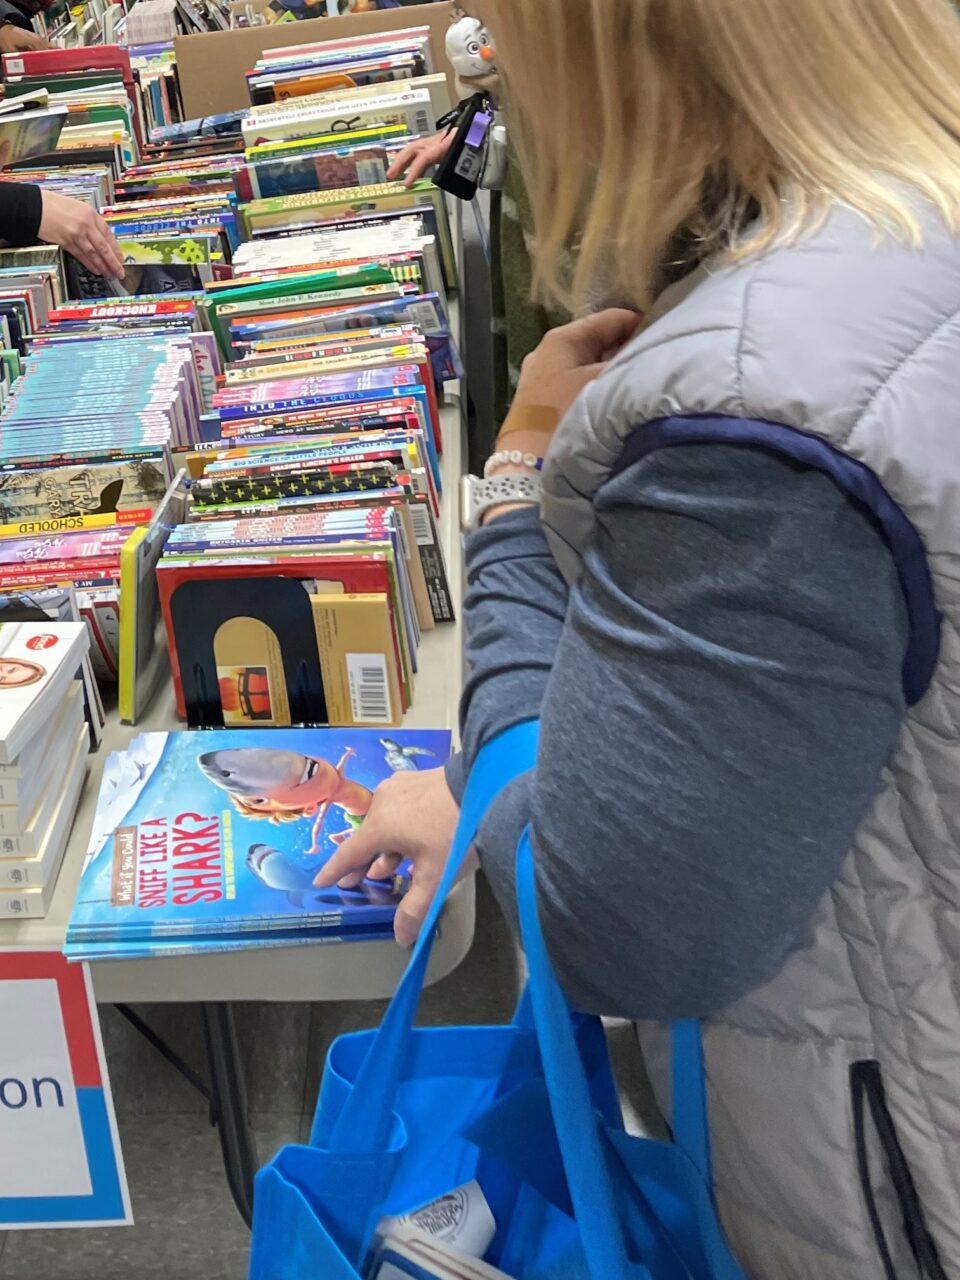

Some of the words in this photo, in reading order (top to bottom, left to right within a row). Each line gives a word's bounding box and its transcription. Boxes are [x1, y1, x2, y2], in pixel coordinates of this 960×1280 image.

[90, 303, 156, 317] KNOCKOUT
[244, 402, 274, 414] INTO
[286, 397, 312, 409] THE
[318, 391, 363, 404] CLOUDS
[19, 517, 84, 533] SCHOOLED
[140, 817, 167, 826] A
[139, 832, 167, 864] LIKE
[172, 812, 222, 905] SHARK?
[138, 869, 167, 908] SNIFF
